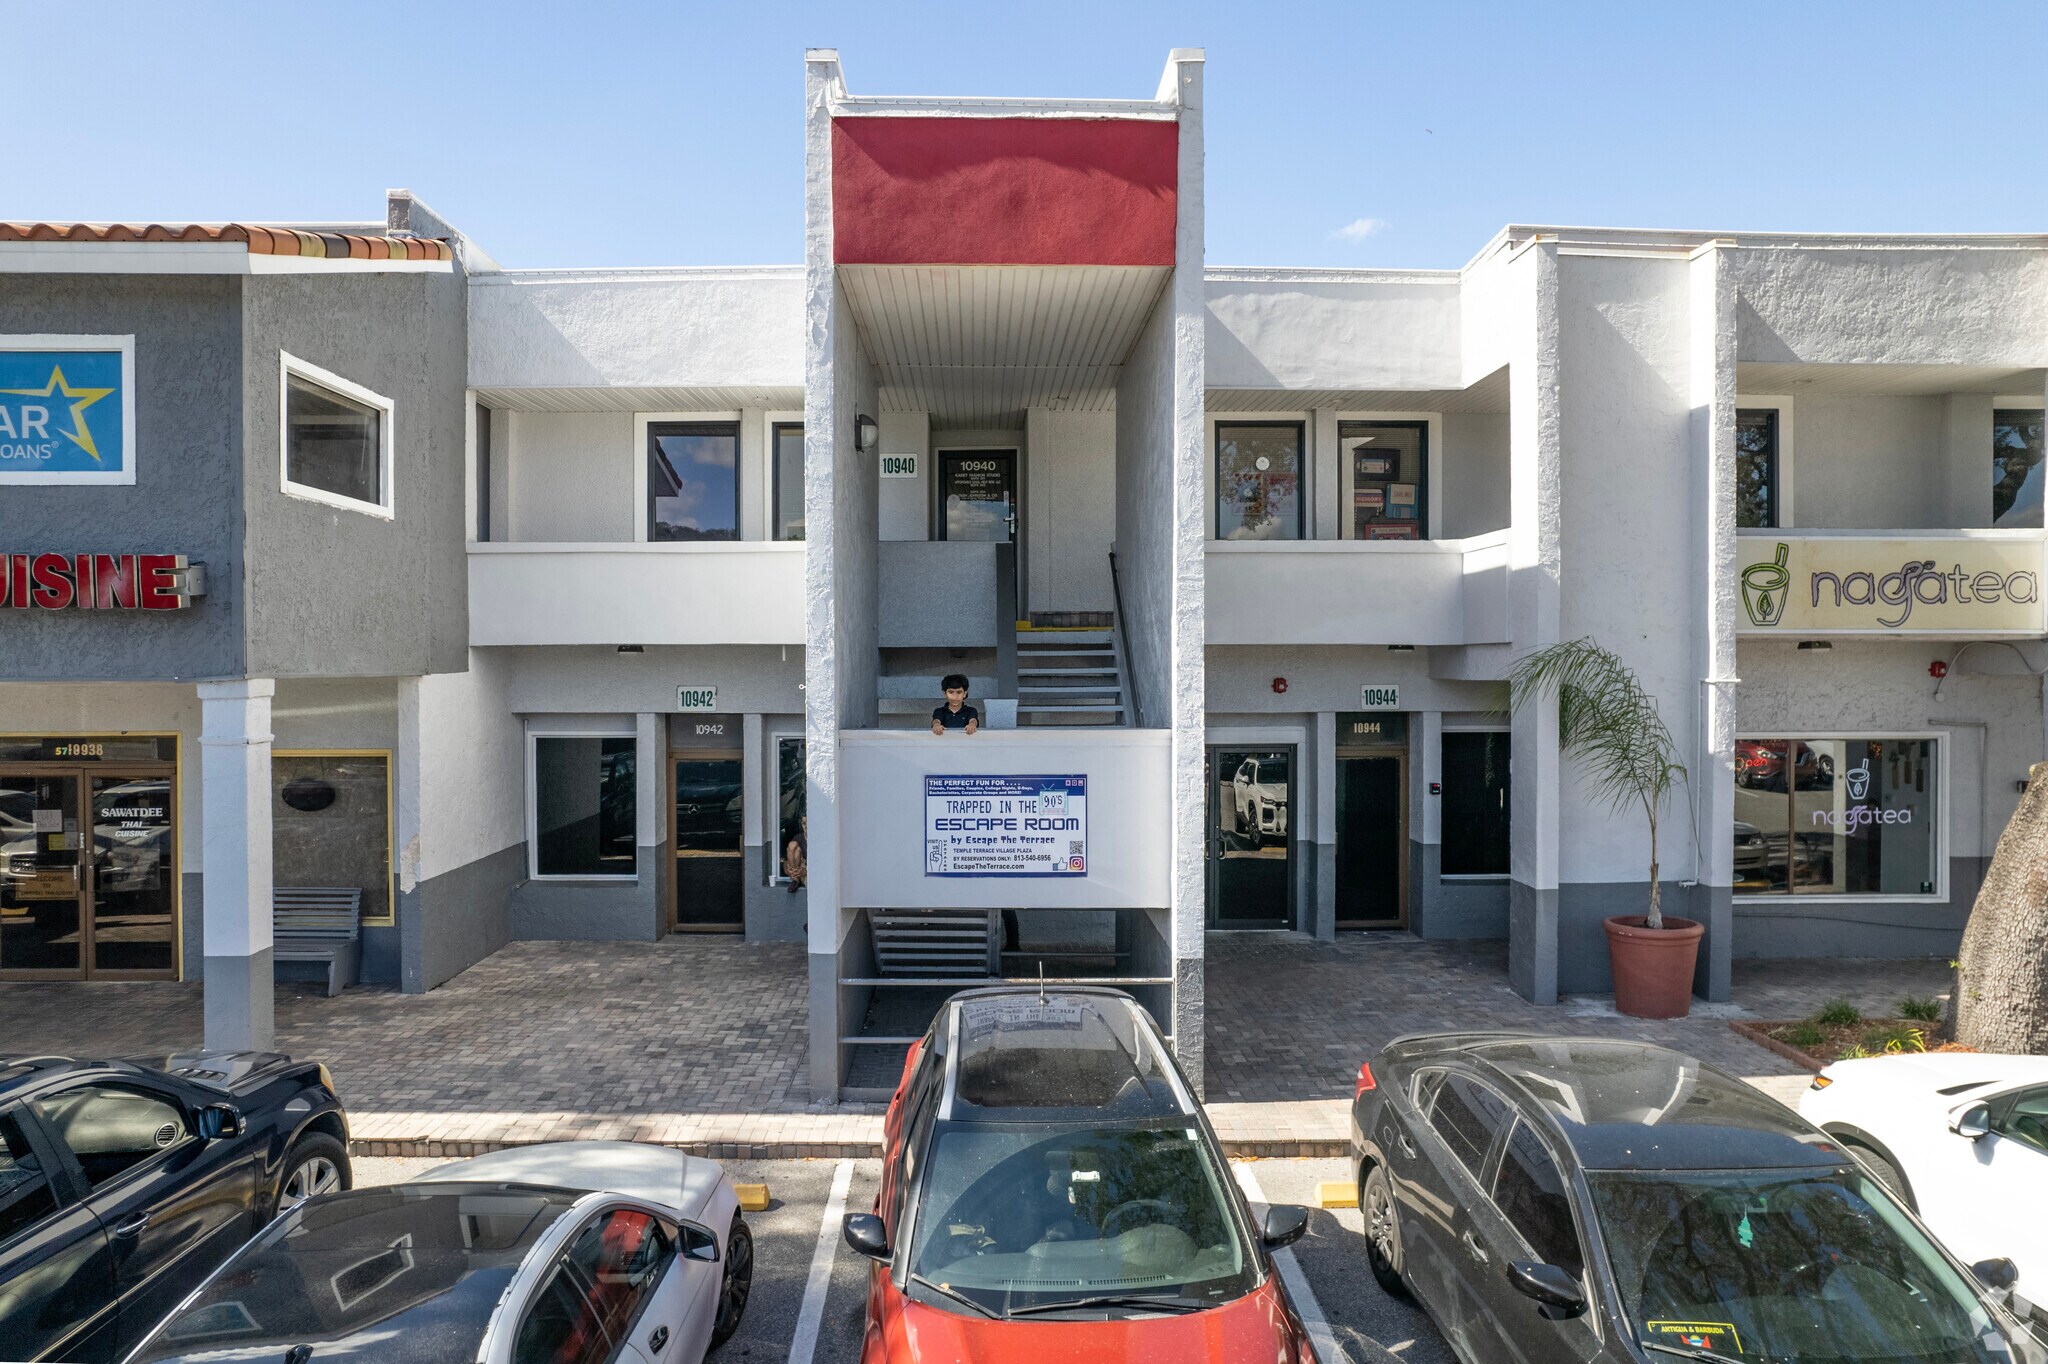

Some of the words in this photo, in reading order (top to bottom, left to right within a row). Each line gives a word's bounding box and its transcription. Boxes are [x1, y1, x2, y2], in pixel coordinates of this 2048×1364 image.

[882, 457, 915, 474] 10940
[960, 461, 996, 471] 10940
[0, 553, 186, 611] ISINE
[1811, 560, 2038, 628] nagatea
[680, 690, 713, 707] 10942
[1364, 689, 1396, 705] 10944
[696, 724, 723, 735] 10942
[1354, 722, 1381, 733] 10944
[101, 807, 163, 817] SAWATDEE
[946, 800, 992, 814] TRAPPED
[1000, 800, 1012, 814] IN
[1018, 800, 1037, 813] THE
[935, 818, 1017, 831] ESCAPE
[1024, 818, 1079, 831] ROOM
[1812, 804, 1911, 835] nagatea
[951, 835, 962, 845] by
[966, 835, 998, 845] Escape
[1000, 835, 1017, 844] The
[1020, 836, 1055, 844] Terrace
[953, 863, 1025, 871] EscapeTheTerrace.com
